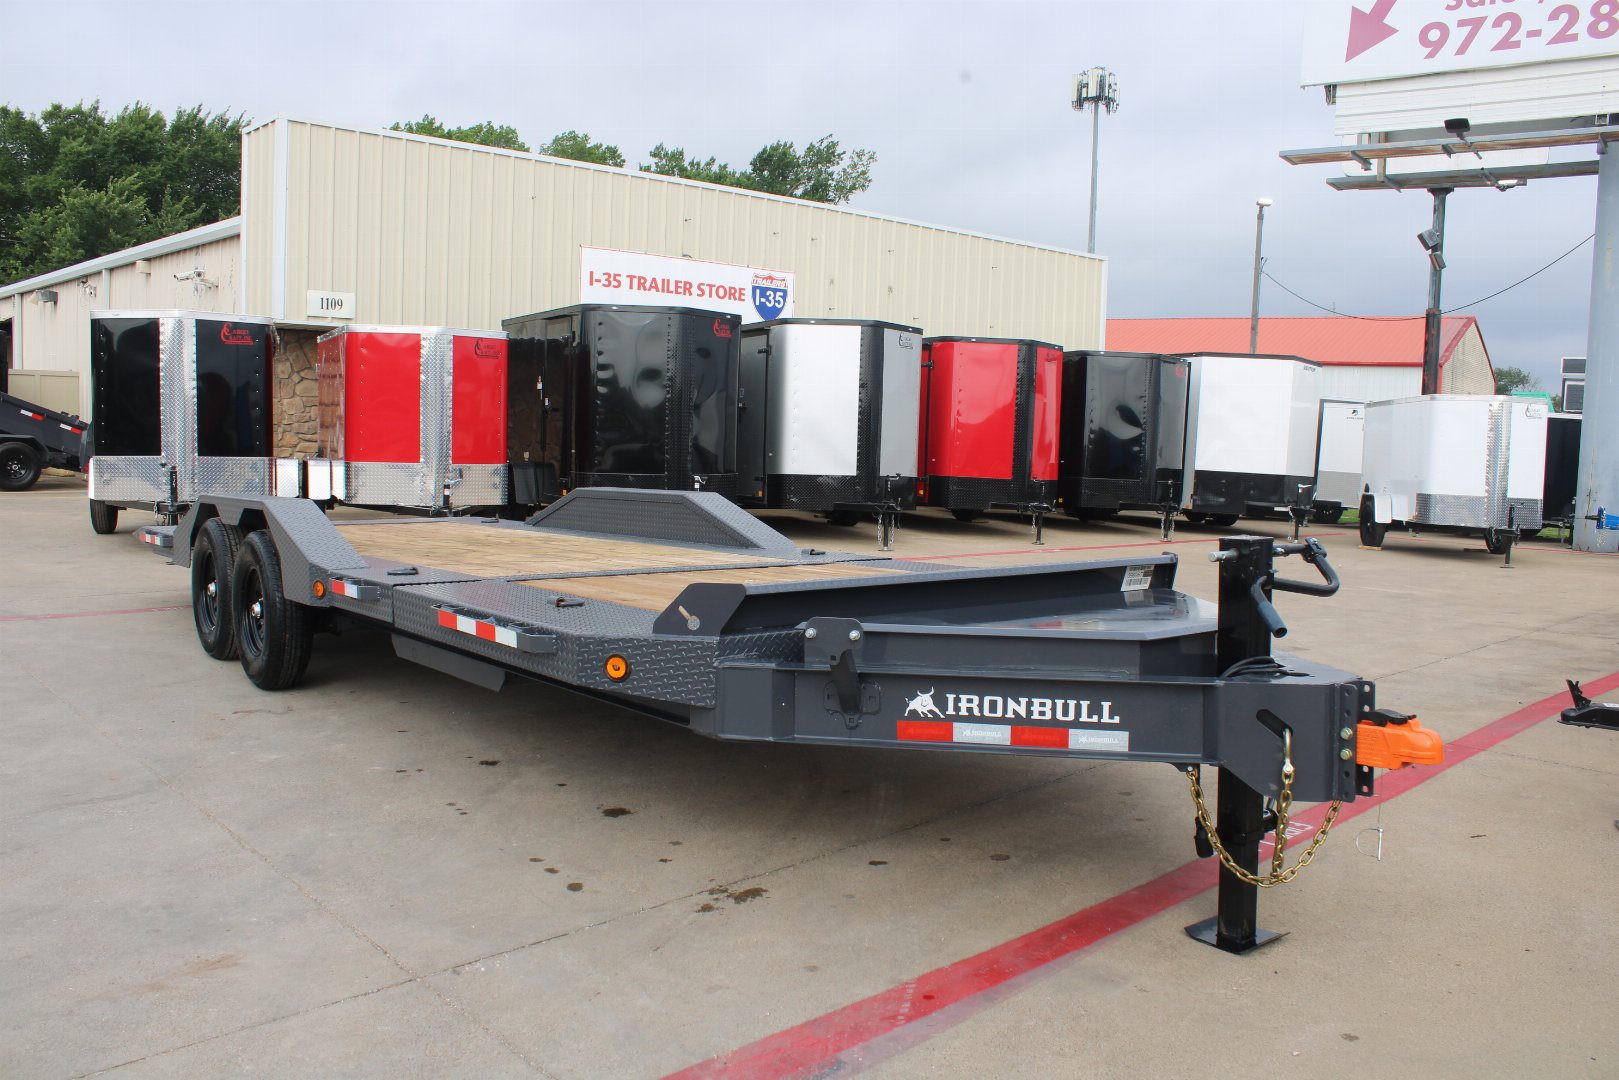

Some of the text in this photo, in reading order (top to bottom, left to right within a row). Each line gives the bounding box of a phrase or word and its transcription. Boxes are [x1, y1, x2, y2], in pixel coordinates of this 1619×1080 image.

[1418, 0, 1619, 59] 972-28
[589, 271, 746, 302] I-35 TRAILER STORE
[752, 278, 787, 289] TRAILERS
[320, 297, 343, 310] 1109
[756, 289, 784, 308] I-35
[945, 693, 1120, 724] IRONBULL
